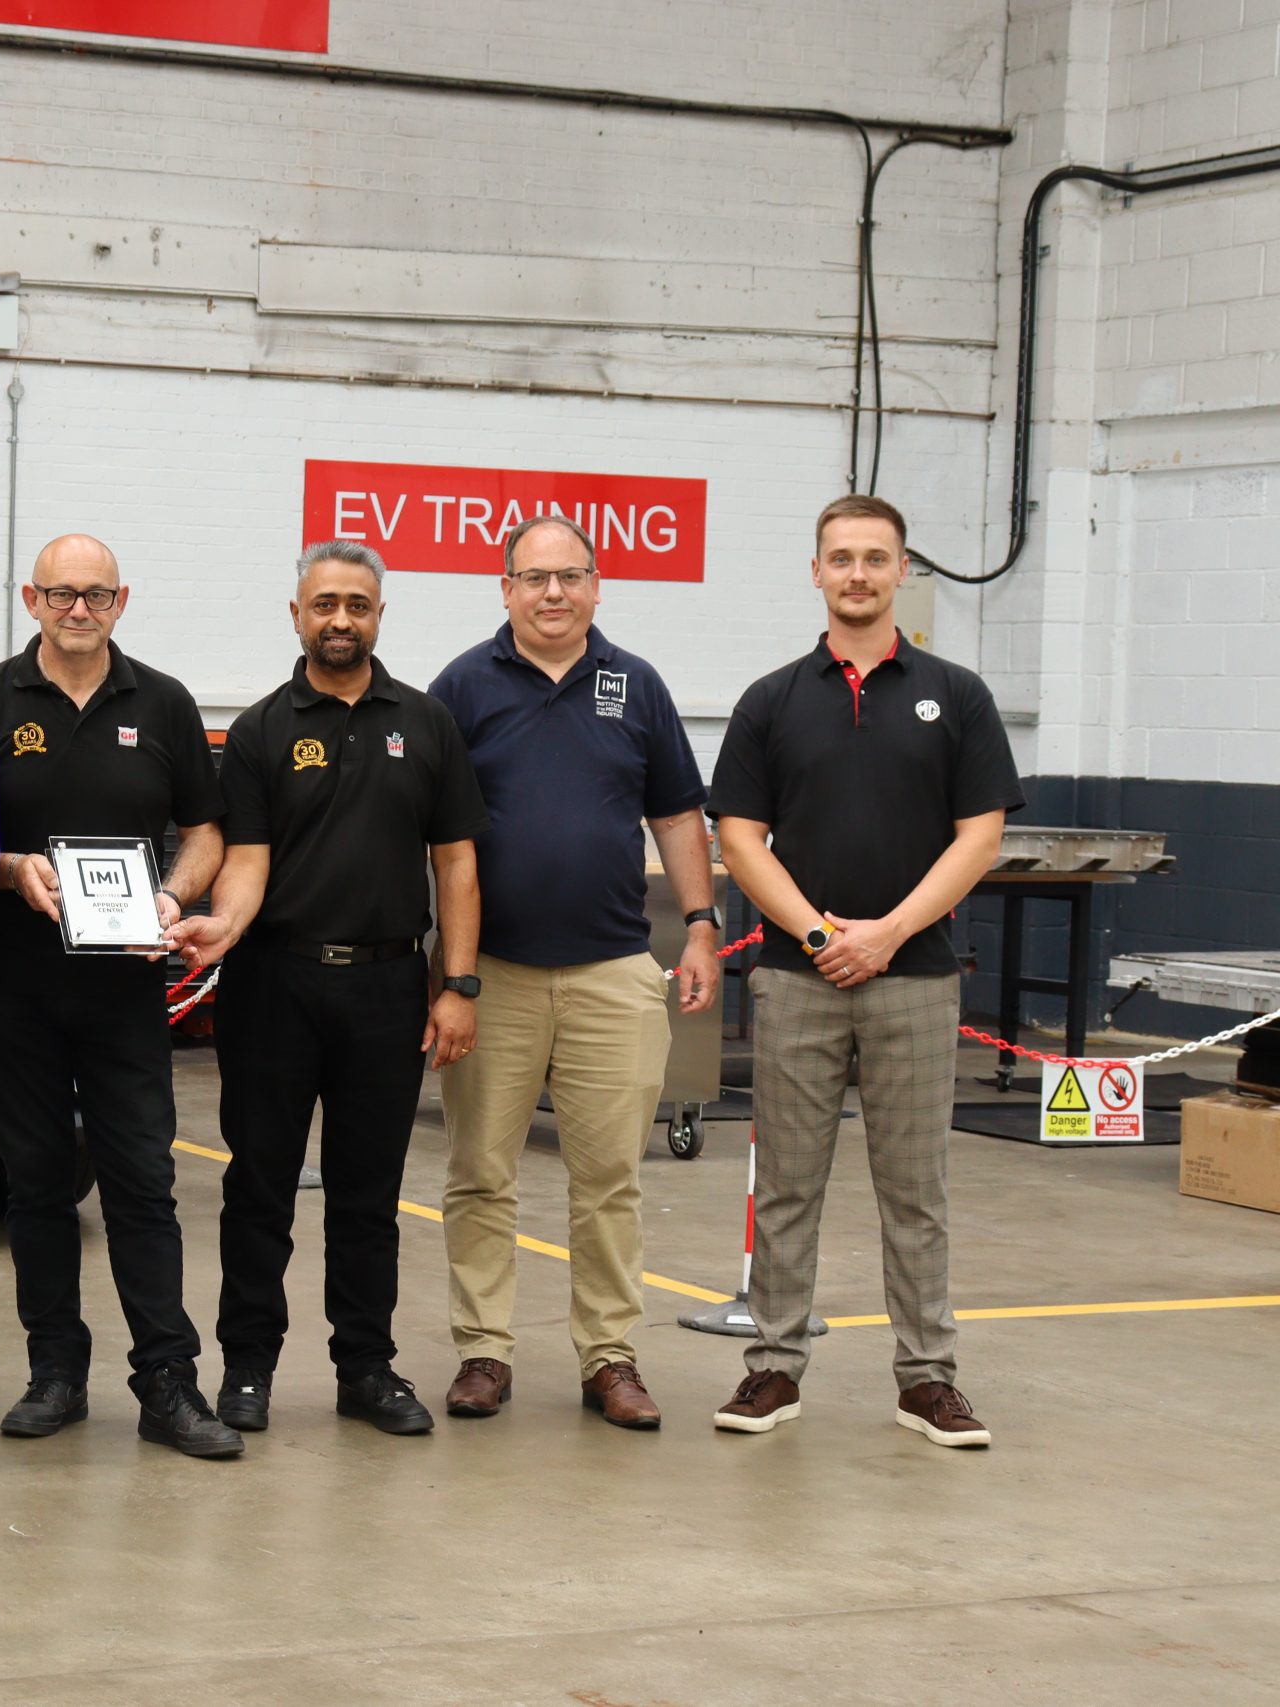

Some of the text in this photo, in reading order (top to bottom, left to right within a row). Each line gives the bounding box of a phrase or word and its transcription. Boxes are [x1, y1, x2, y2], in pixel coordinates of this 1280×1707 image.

[334, 491, 407, 541] EV
[602, 679, 621, 693] IMI
[917, 702, 938, 719] MG
[21, 729, 36, 741] 30
[121, 732, 136, 740] GH
[301, 745, 317, 756] 30
[89, 871, 120, 885] IMI
[1050, 1115, 1087, 1127] Danger
[1096, 1115, 1138, 1124] No access
[1049, 1128, 1088, 1136] High voltage
